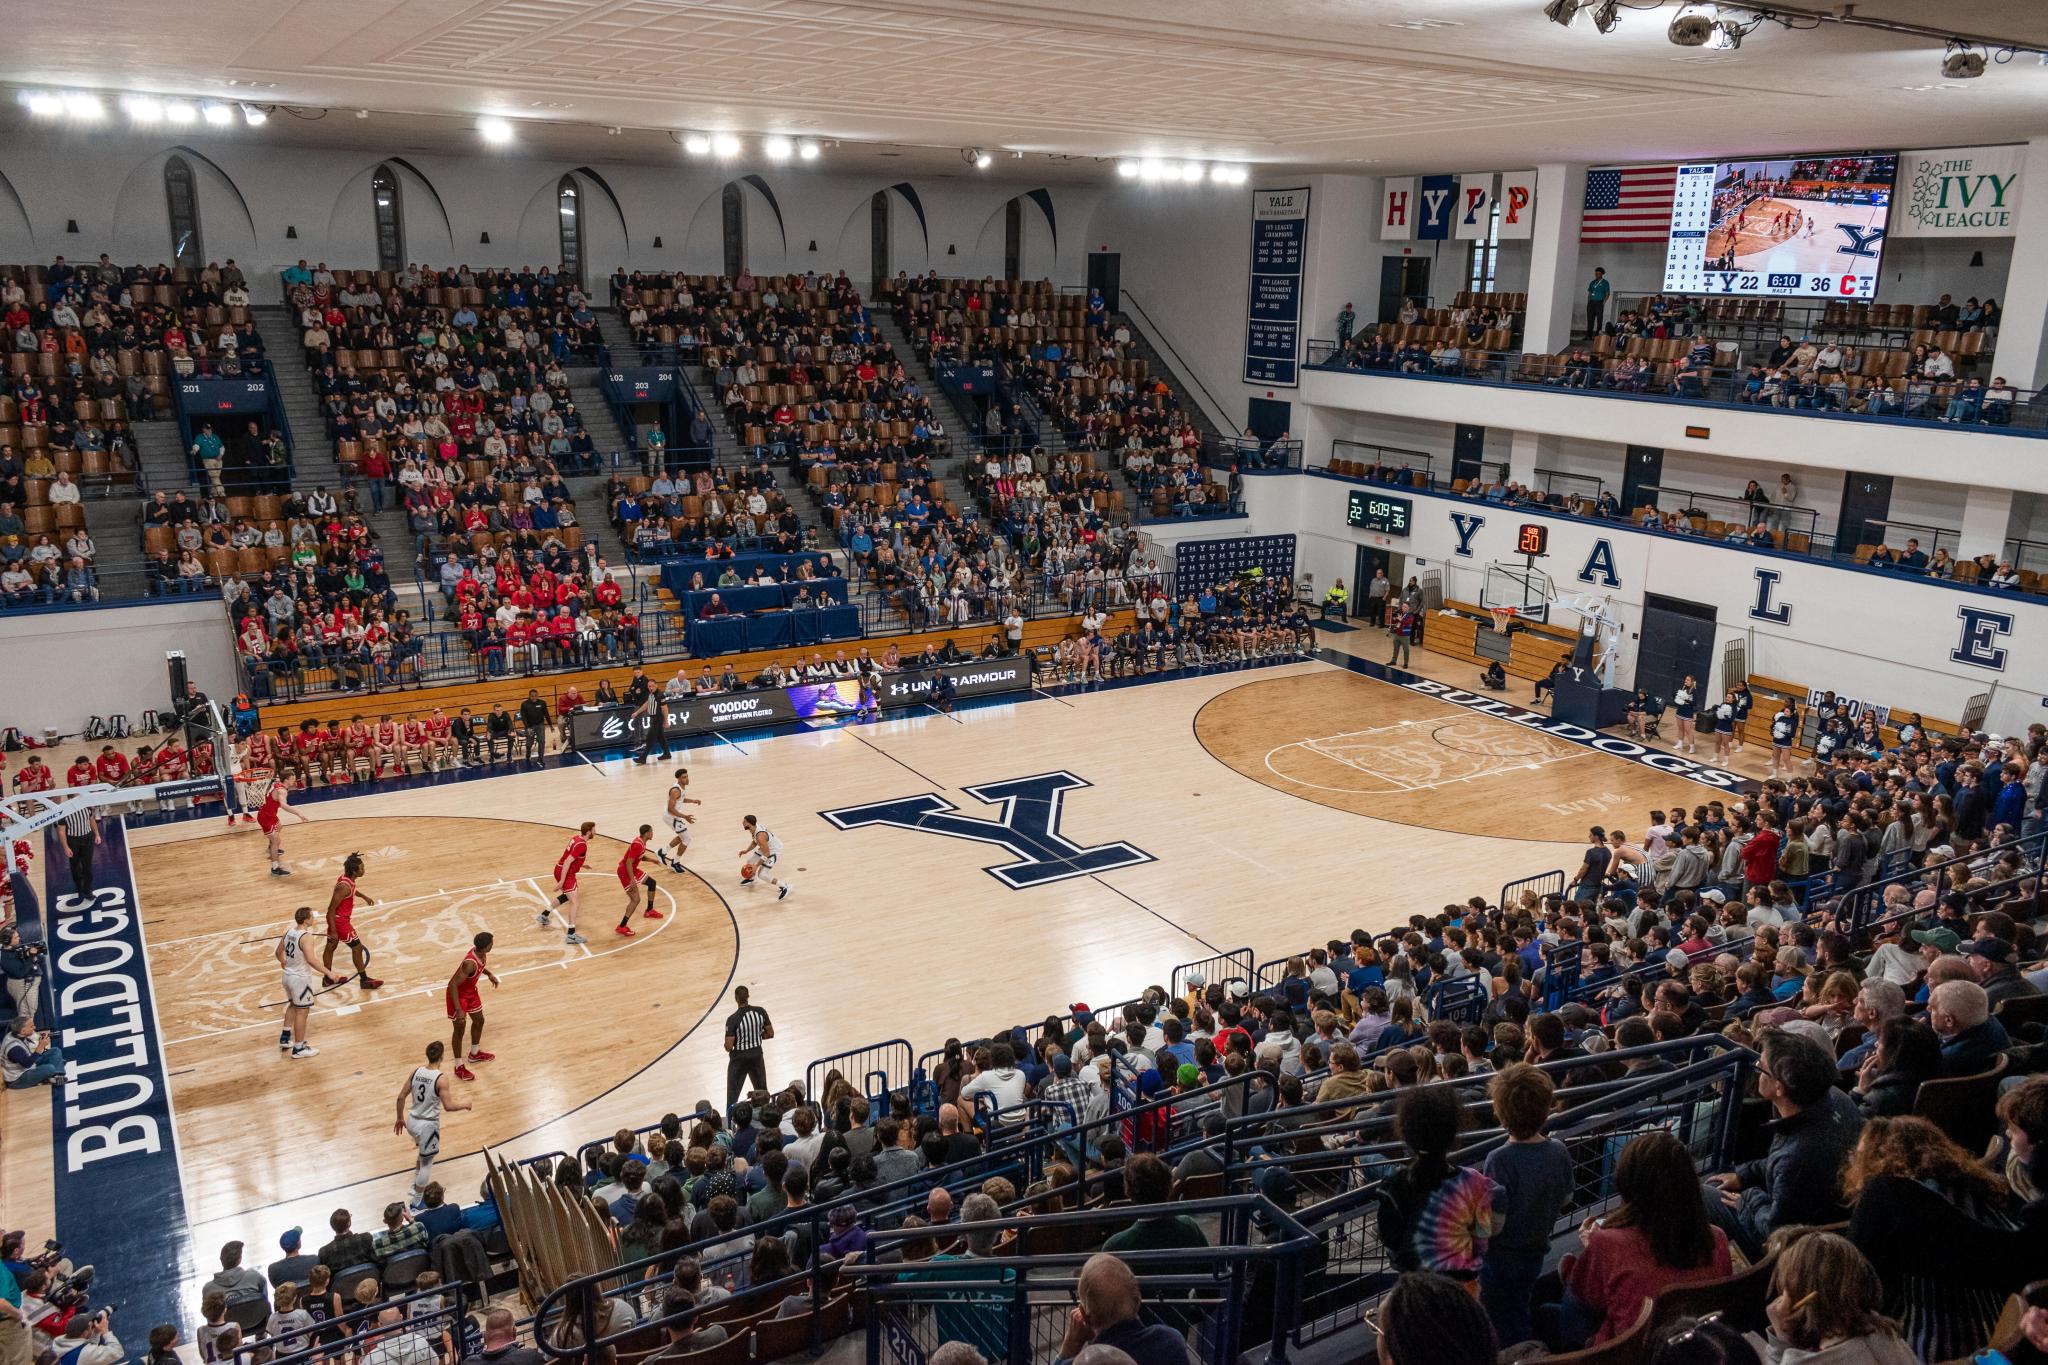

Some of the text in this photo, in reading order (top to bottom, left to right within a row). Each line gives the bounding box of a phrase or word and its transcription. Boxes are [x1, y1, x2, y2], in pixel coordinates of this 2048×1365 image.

[1944, 160, 1973, 172] THE
[1935, 173, 2016, 208] IVY
[1269, 196, 1293, 207] YALE
[1387, 187, 1529, 226] H Y P P
[1934, 211, 2010, 227] LEAGUE
[1719, 273, 1856, 295] Y 22 6:10 36 C
[183, 384, 200, 393] 201
[247, 383, 264, 392] 202
[1350, 506, 1362, 520] 22
[1369, 501, 1389, 516] 6:09
[1392, 513, 1405, 528] 36
[1521, 534, 1539, 552] 20
[1449, 511, 2015, 672] Y A L E
[253, 644, 263, 654] 13
[911, 669, 1016, 693] UNR ARMOUR
[1572, 667, 1584, 682] Y
[628, 711, 690, 731] CURY
[712, 714, 731, 723] CURRY
[731, 712, 753, 721] SPAWN
[1400, 679, 1748, 786] BULLDOGS
[191, 784, 219, 792] ARMOUR
[30, 810, 63, 829] LEGACY
[816, 770, 1160, 891] Y
[285, 941, 295, 959] 42
[1448, 1008, 1467, 1021] 109
[55, 886, 161, 1172] BULLDOGS
[417, 1084, 426, 1103] 3
[892, 1327, 917, 1365] 210
